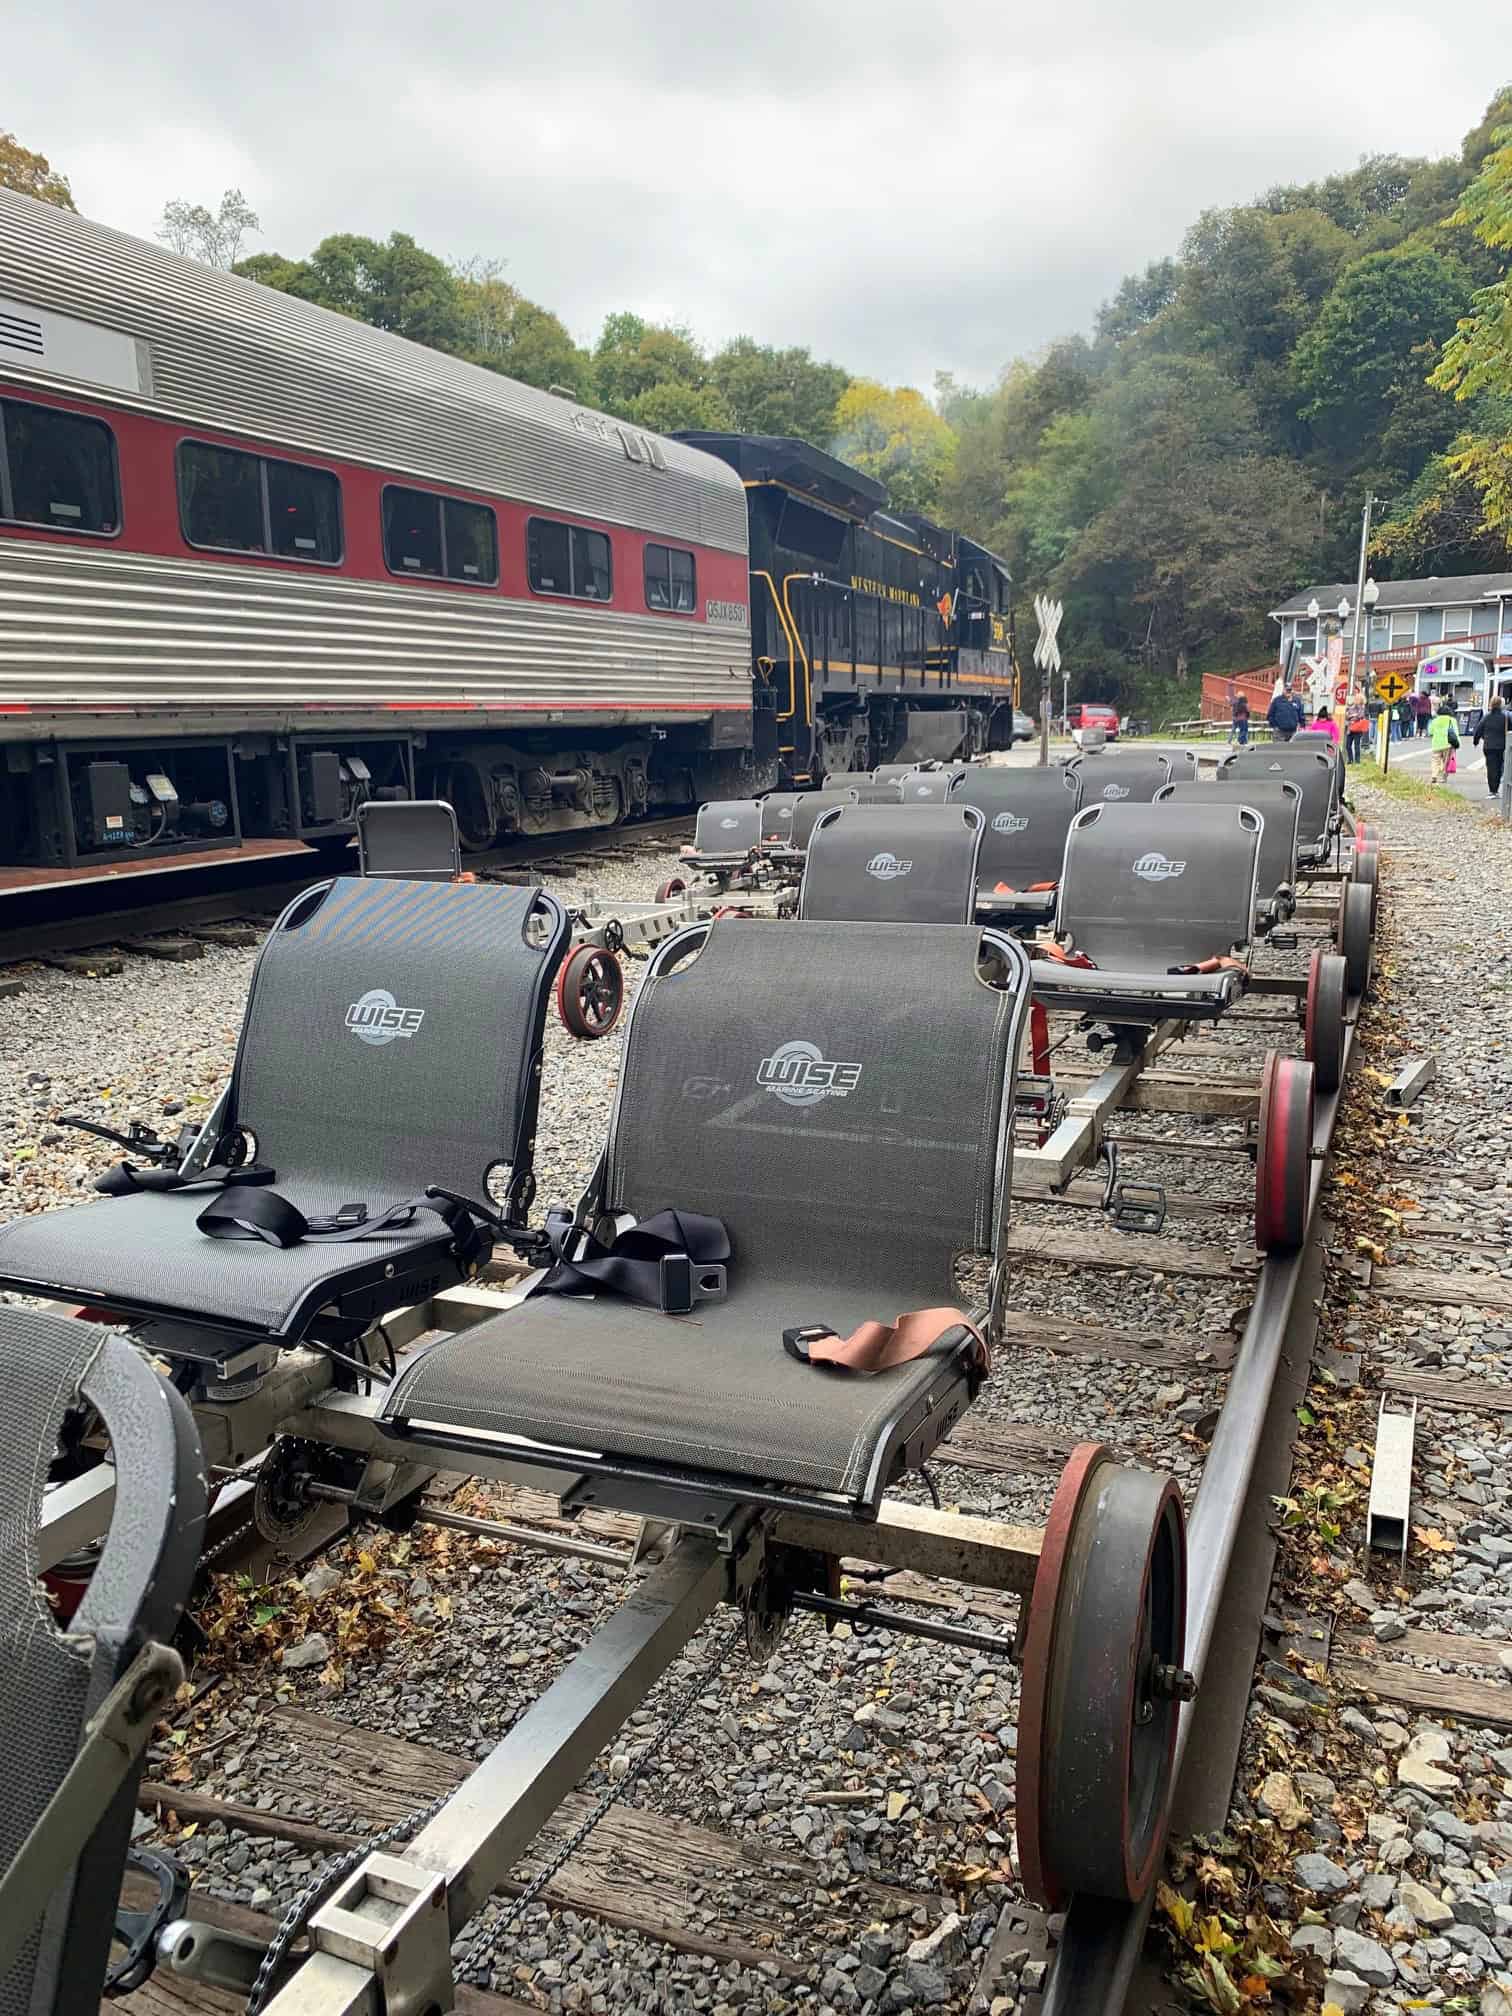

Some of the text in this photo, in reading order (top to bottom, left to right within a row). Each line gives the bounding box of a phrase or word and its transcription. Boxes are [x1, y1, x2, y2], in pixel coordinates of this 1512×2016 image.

[991, 817, 1030, 830] WISE
[866, 861, 913, 873] WISE
[1133, 861, 1187, 873] WISE
[345, 1004, 424, 1032] WISE
[757, 1059, 862, 1090] WISE
